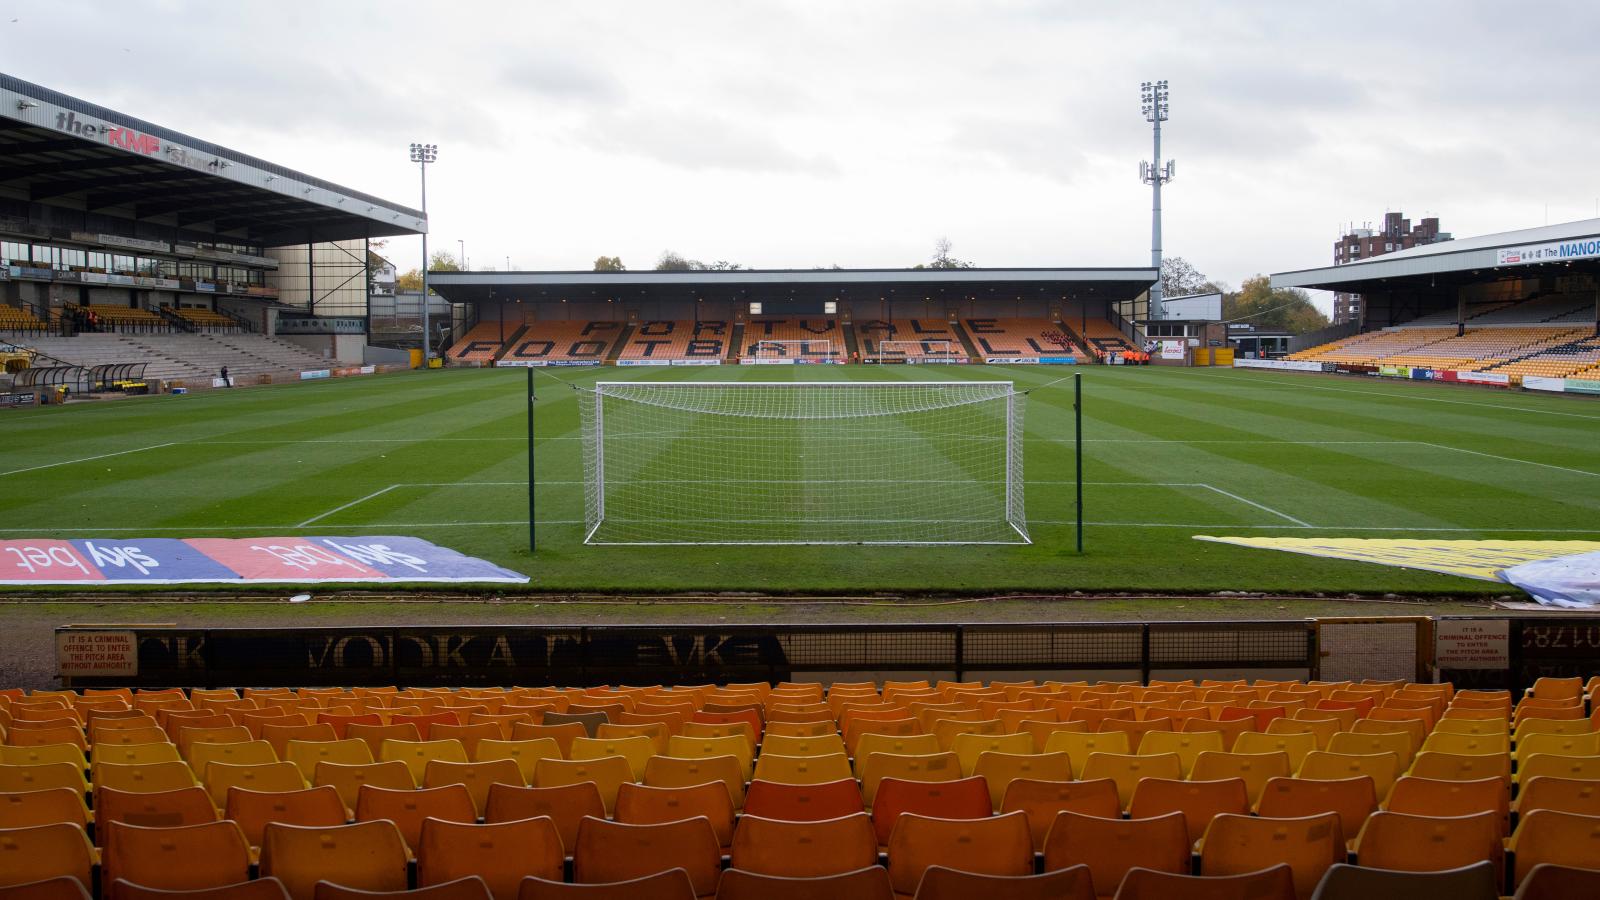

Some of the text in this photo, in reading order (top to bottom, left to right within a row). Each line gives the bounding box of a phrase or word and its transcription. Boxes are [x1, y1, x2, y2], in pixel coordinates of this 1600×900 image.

[55, 111, 97, 139] the
[109, 127, 161, 156] KMF
[1544, 247, 1558, 258] The
[5, 541, 160, 576] sky bet
[251, 539, 428, 573] sky bet
[68, 635, 129, 643] IT IS A CRIMINAL
[63, 644, 131, 652] OFFENCE TO ENTER
[70, 653, 126, 661] THE PITCH AREA
[61, 662, 133, 670] WITHOUT AUTHORITY
